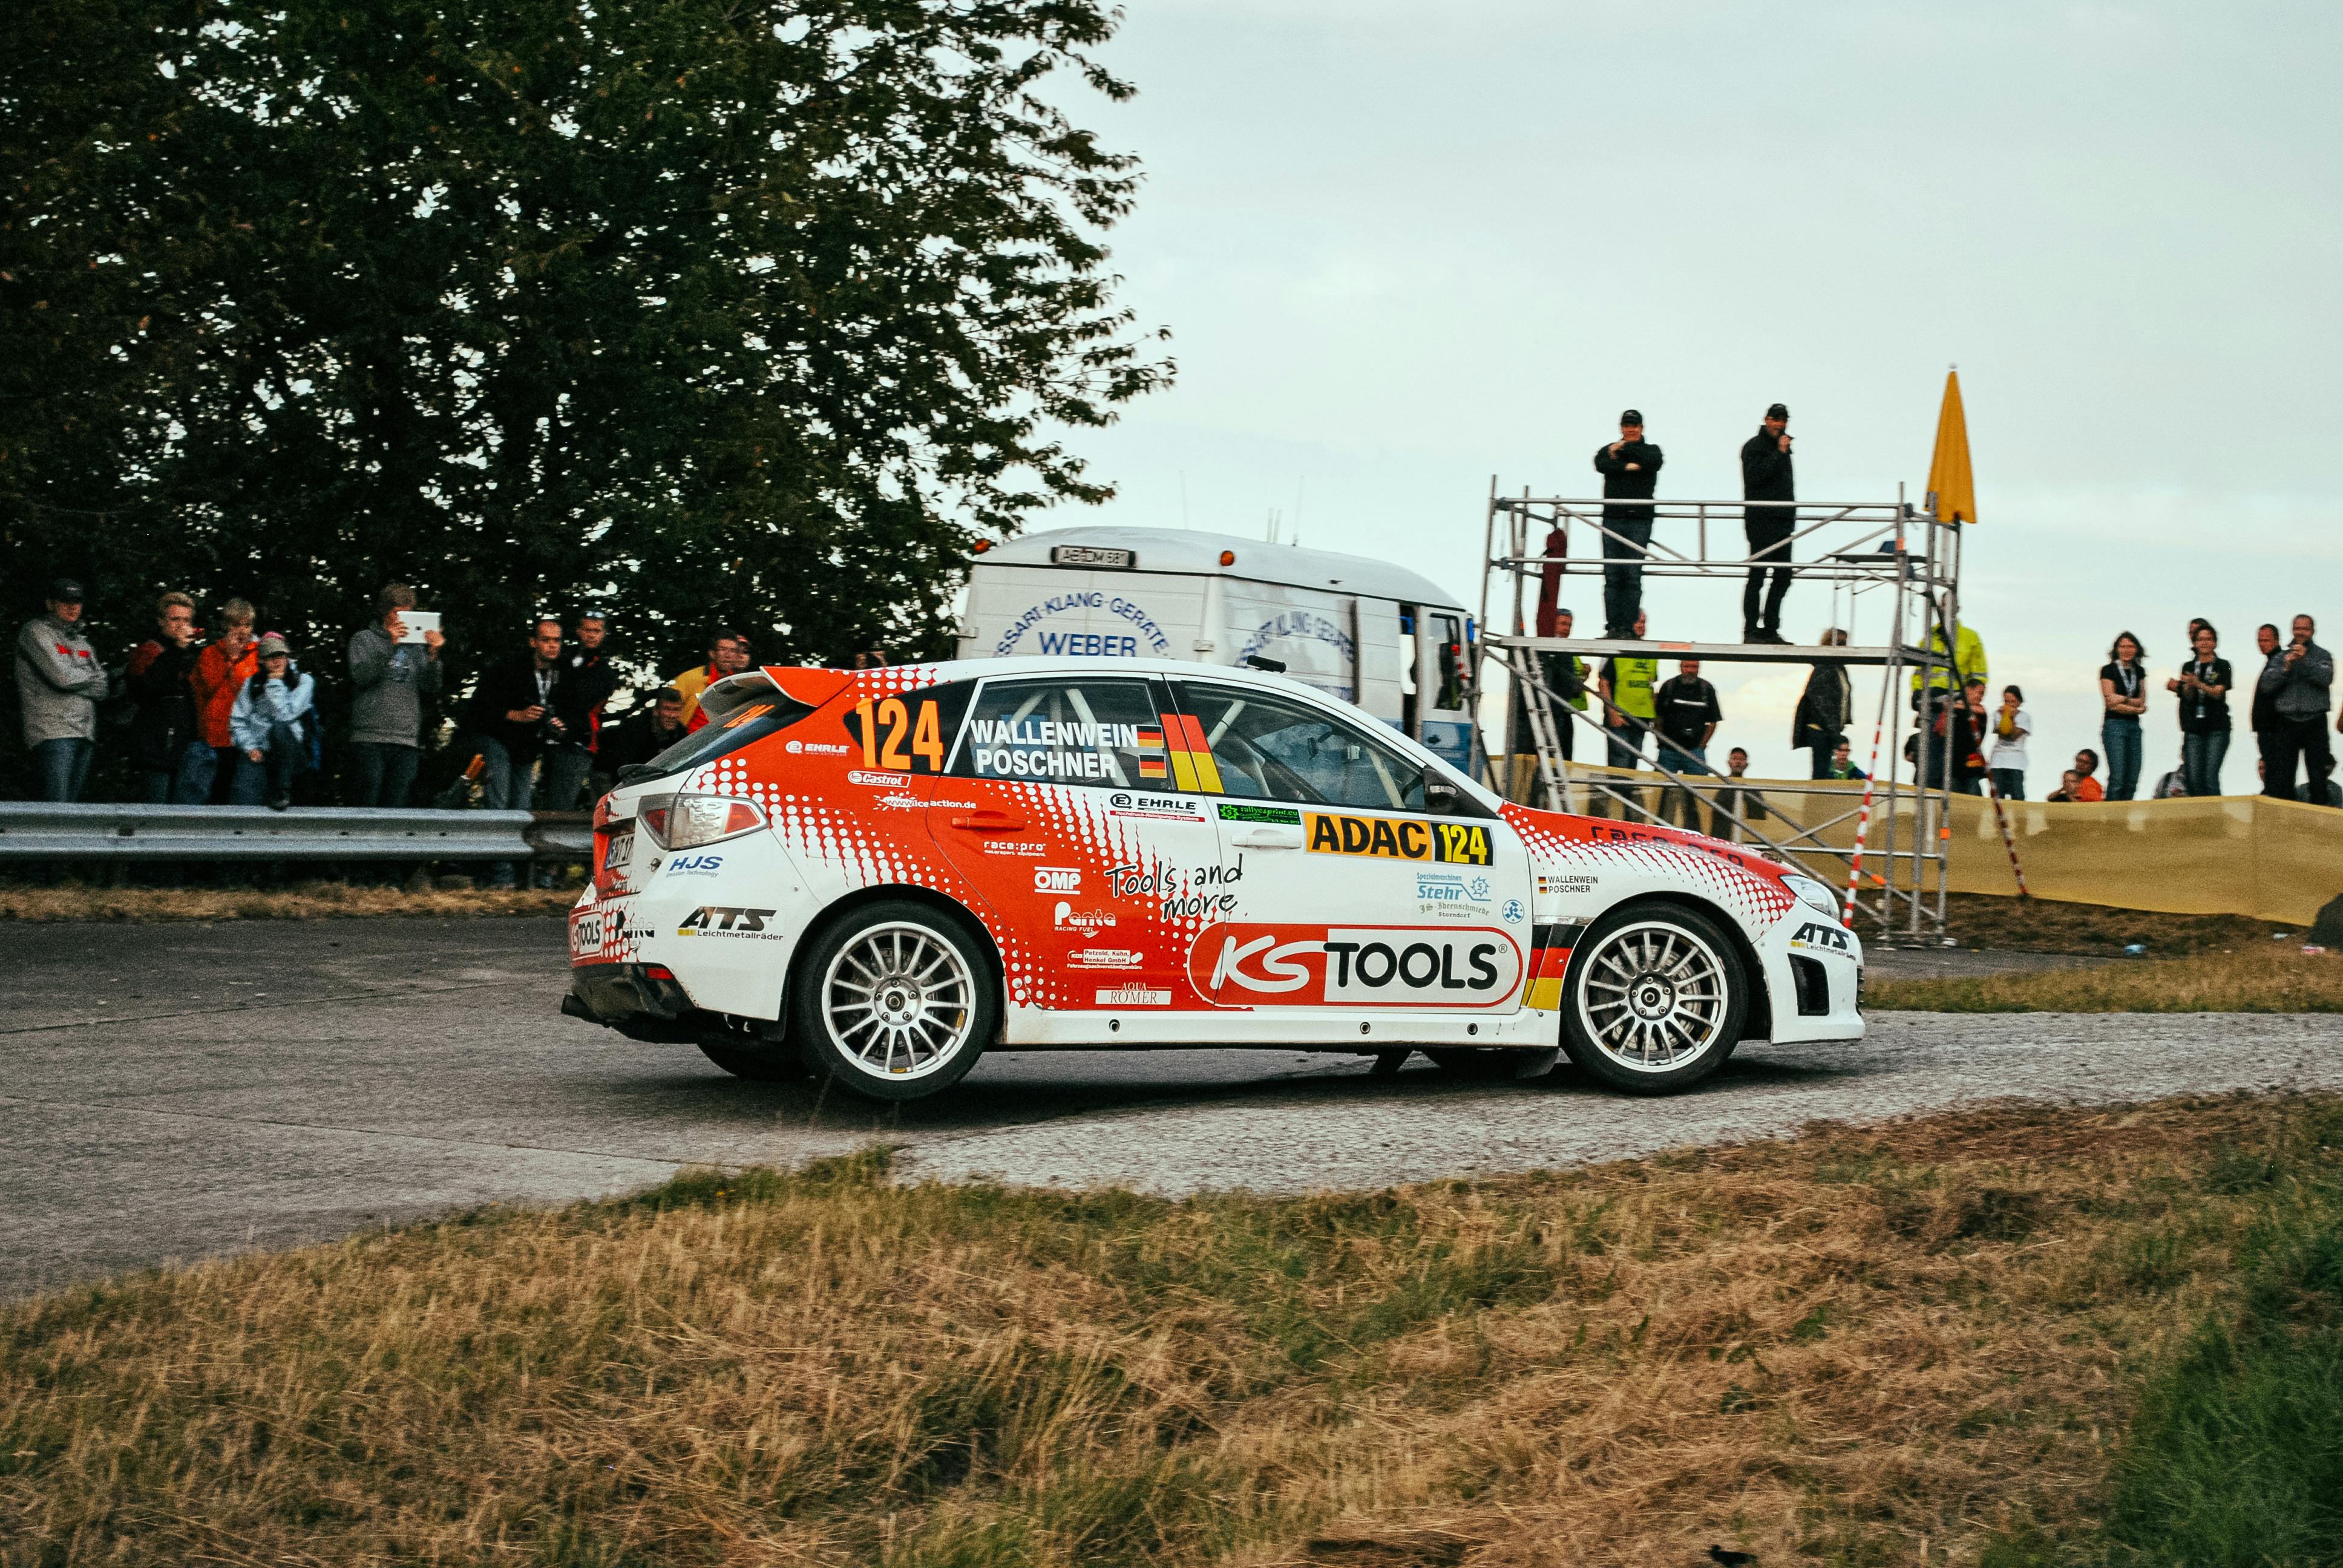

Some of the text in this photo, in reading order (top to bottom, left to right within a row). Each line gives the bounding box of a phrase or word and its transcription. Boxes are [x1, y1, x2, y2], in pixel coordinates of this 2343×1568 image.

[1038, 631, 1137, 657] WEBER
[856, 698, 943, 771] 124
[970, 719, 1139, 748] WALLENWEIN
[805, 743, 848, 753] EHRLE
[976, 749, 1117, 778] POSCHNER
[862, 774, 902, 785] Castrol
[1138, 798, 1196, 809] EHRLE
[1312, 815, 1488, 865] ADAC 124
[669, 856, 723, 871] HJS
[1105, 852, 1243, 897] Tools and
[1034, 871, 1081, 890] OMP
[1417, 872, 1462, 881] Spezialmaschinen
[1548, 885, 1590, 893] POSCHNER
[1417, 885, 1463, 900] Stehr
[678, 906, 777, 932] ATS
[1055, 901, 1116, 926] Panta
[1163, 894, 1238, 920] more
[578, 920, 600, 946] TOOLS
[697, 930, 784, 940] Leichtmetallräder
[1791, 922, 1850, 950] ATS
[1210, 935, 1328, 993] KS
[1110, 991, 1158, 1004] RÖMER
[1121, 982, 1147, 990] AQUA
